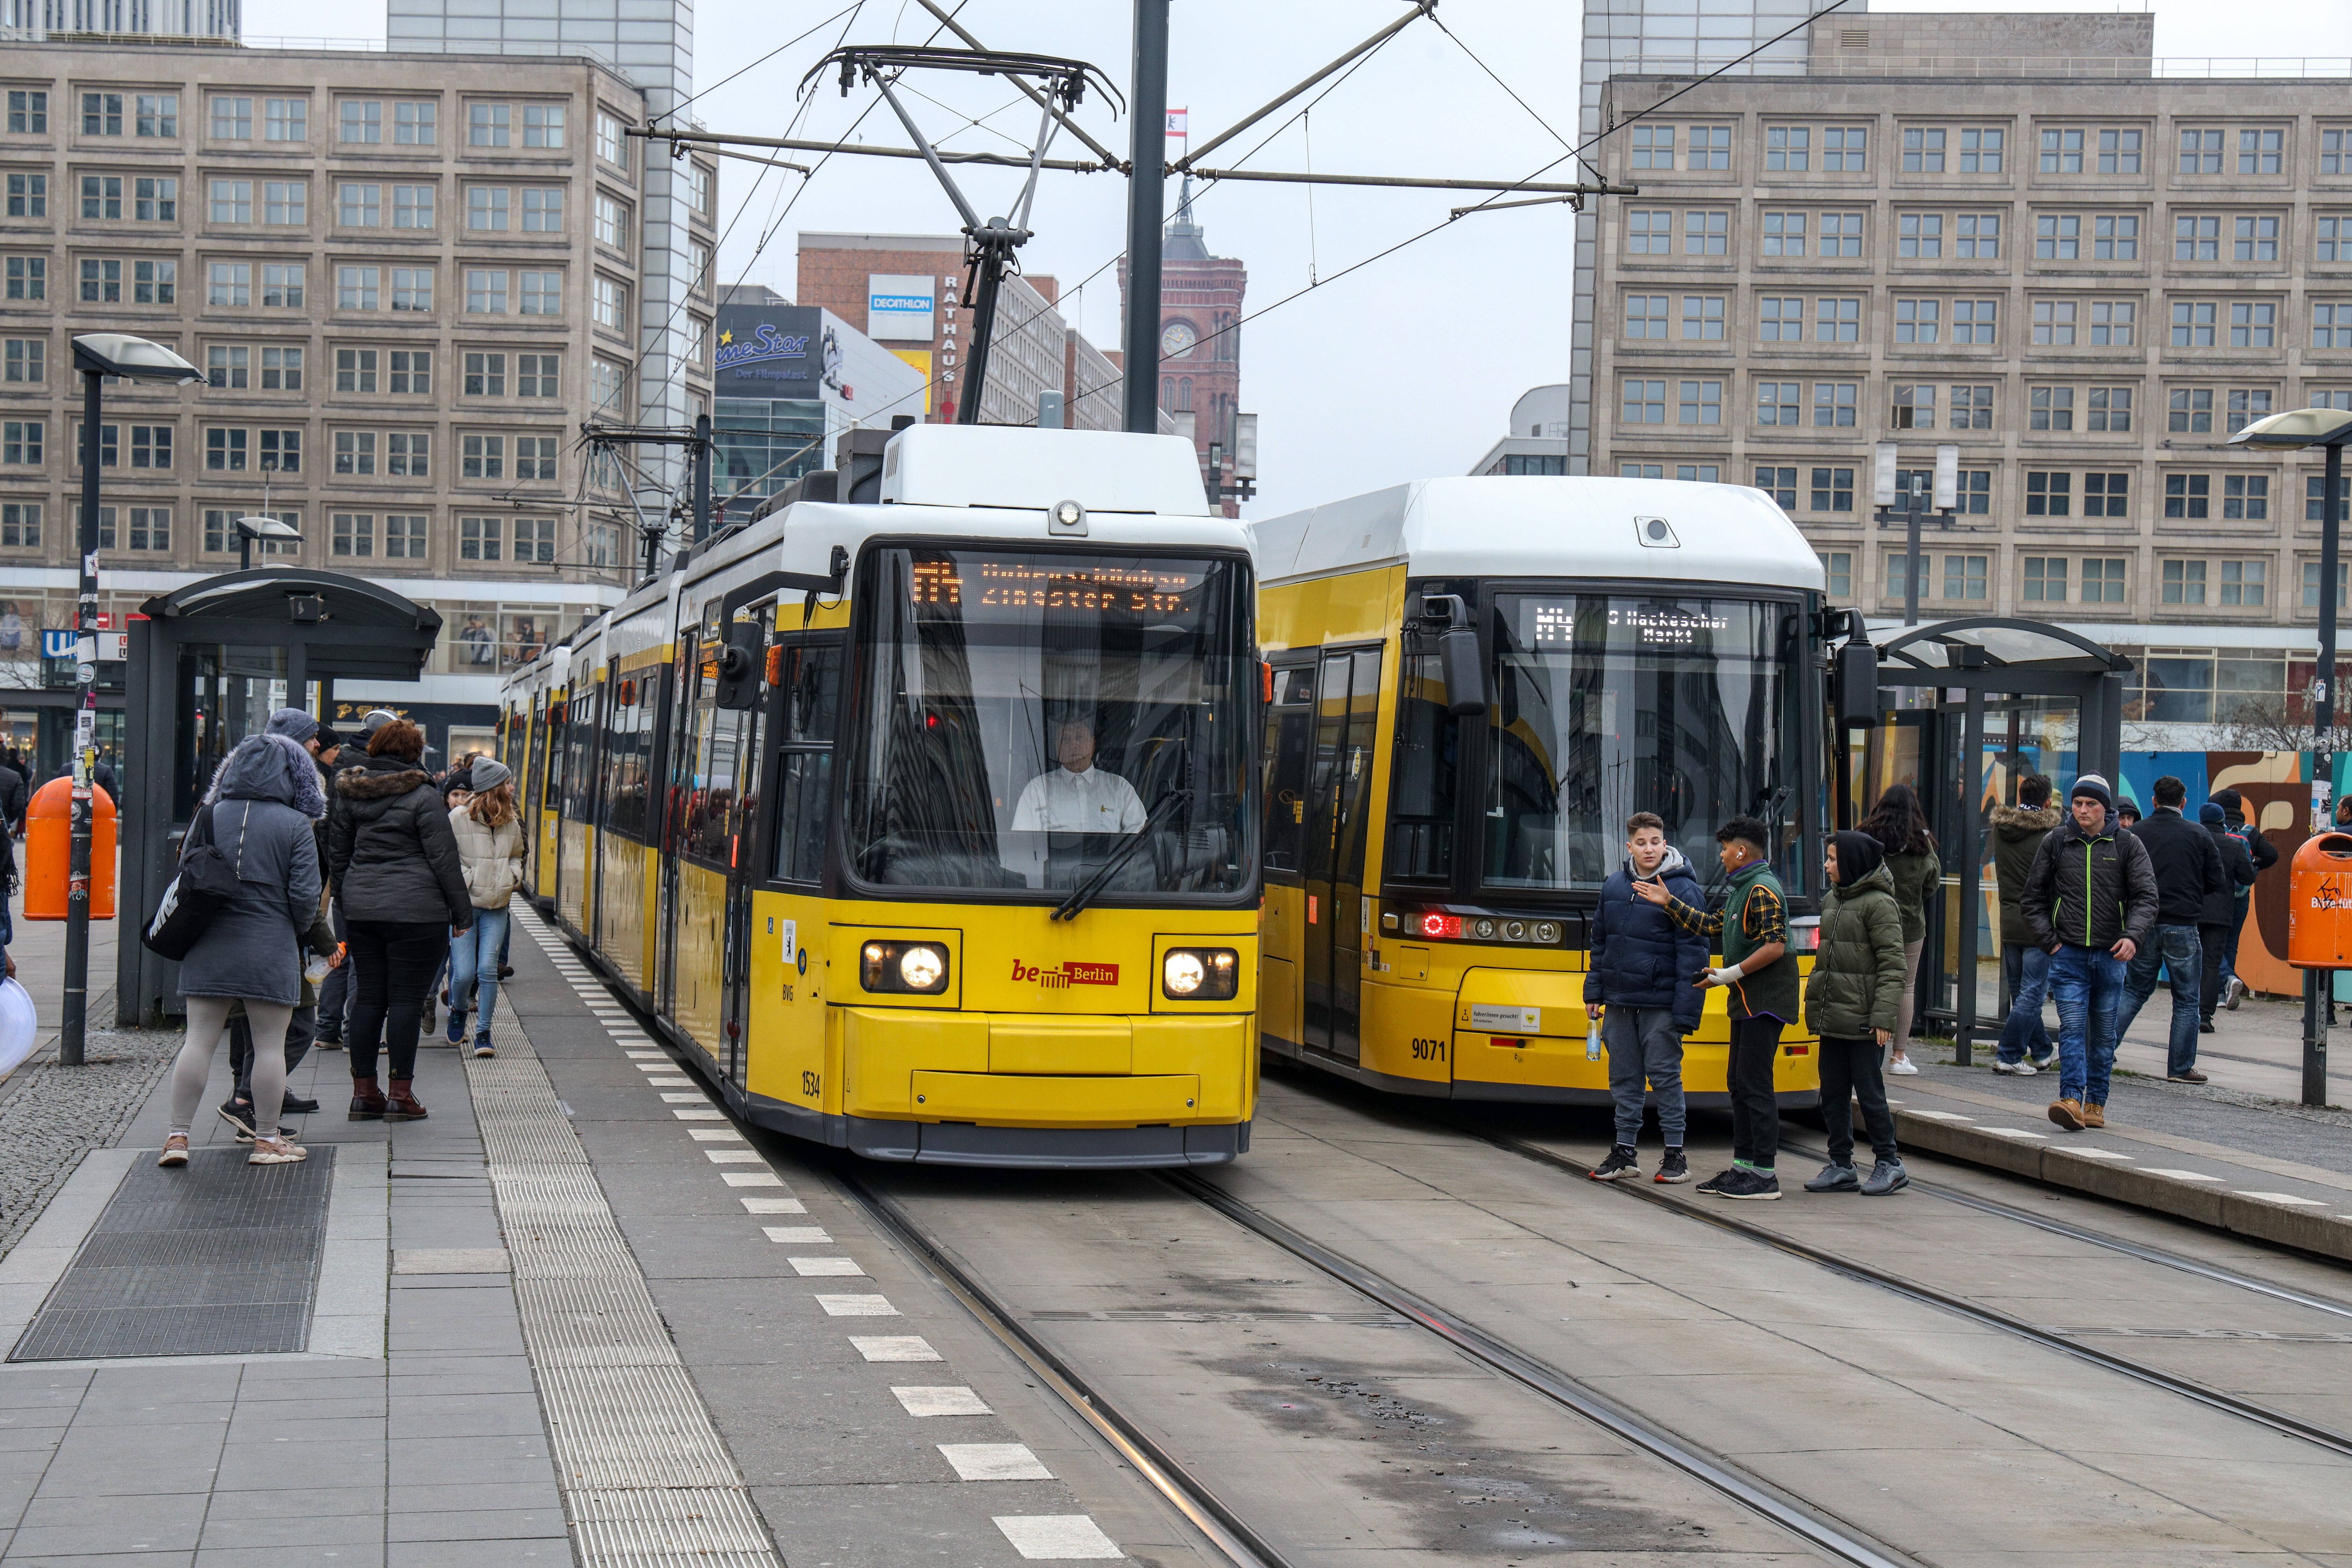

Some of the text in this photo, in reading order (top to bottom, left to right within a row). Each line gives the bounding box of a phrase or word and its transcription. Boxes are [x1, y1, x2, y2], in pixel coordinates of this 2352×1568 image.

[874, 298, 930, 309] DECATHLON
[942, 276, 958, 382] RATHAUS
[715, 324, 809, 363] ineStar
[735, 368, 753, 378] Der
[1132, 593, 1189, 611] Str.
[1536, 608, 1574, 641] M4
[1627, 611, 1728, 628] Hackescher
[1644, 629, 1693, 643] Markt
[46, 632, 67, 657] U
[2311, 897, 2336, 909] Bitte
[1011, 959, 1113, 982] be Berlin
[783, 984, 793, 1002] BVG
[1412, 1038, 1445, 1062] 9071
[802, 1070, 820, 1099] 1534
